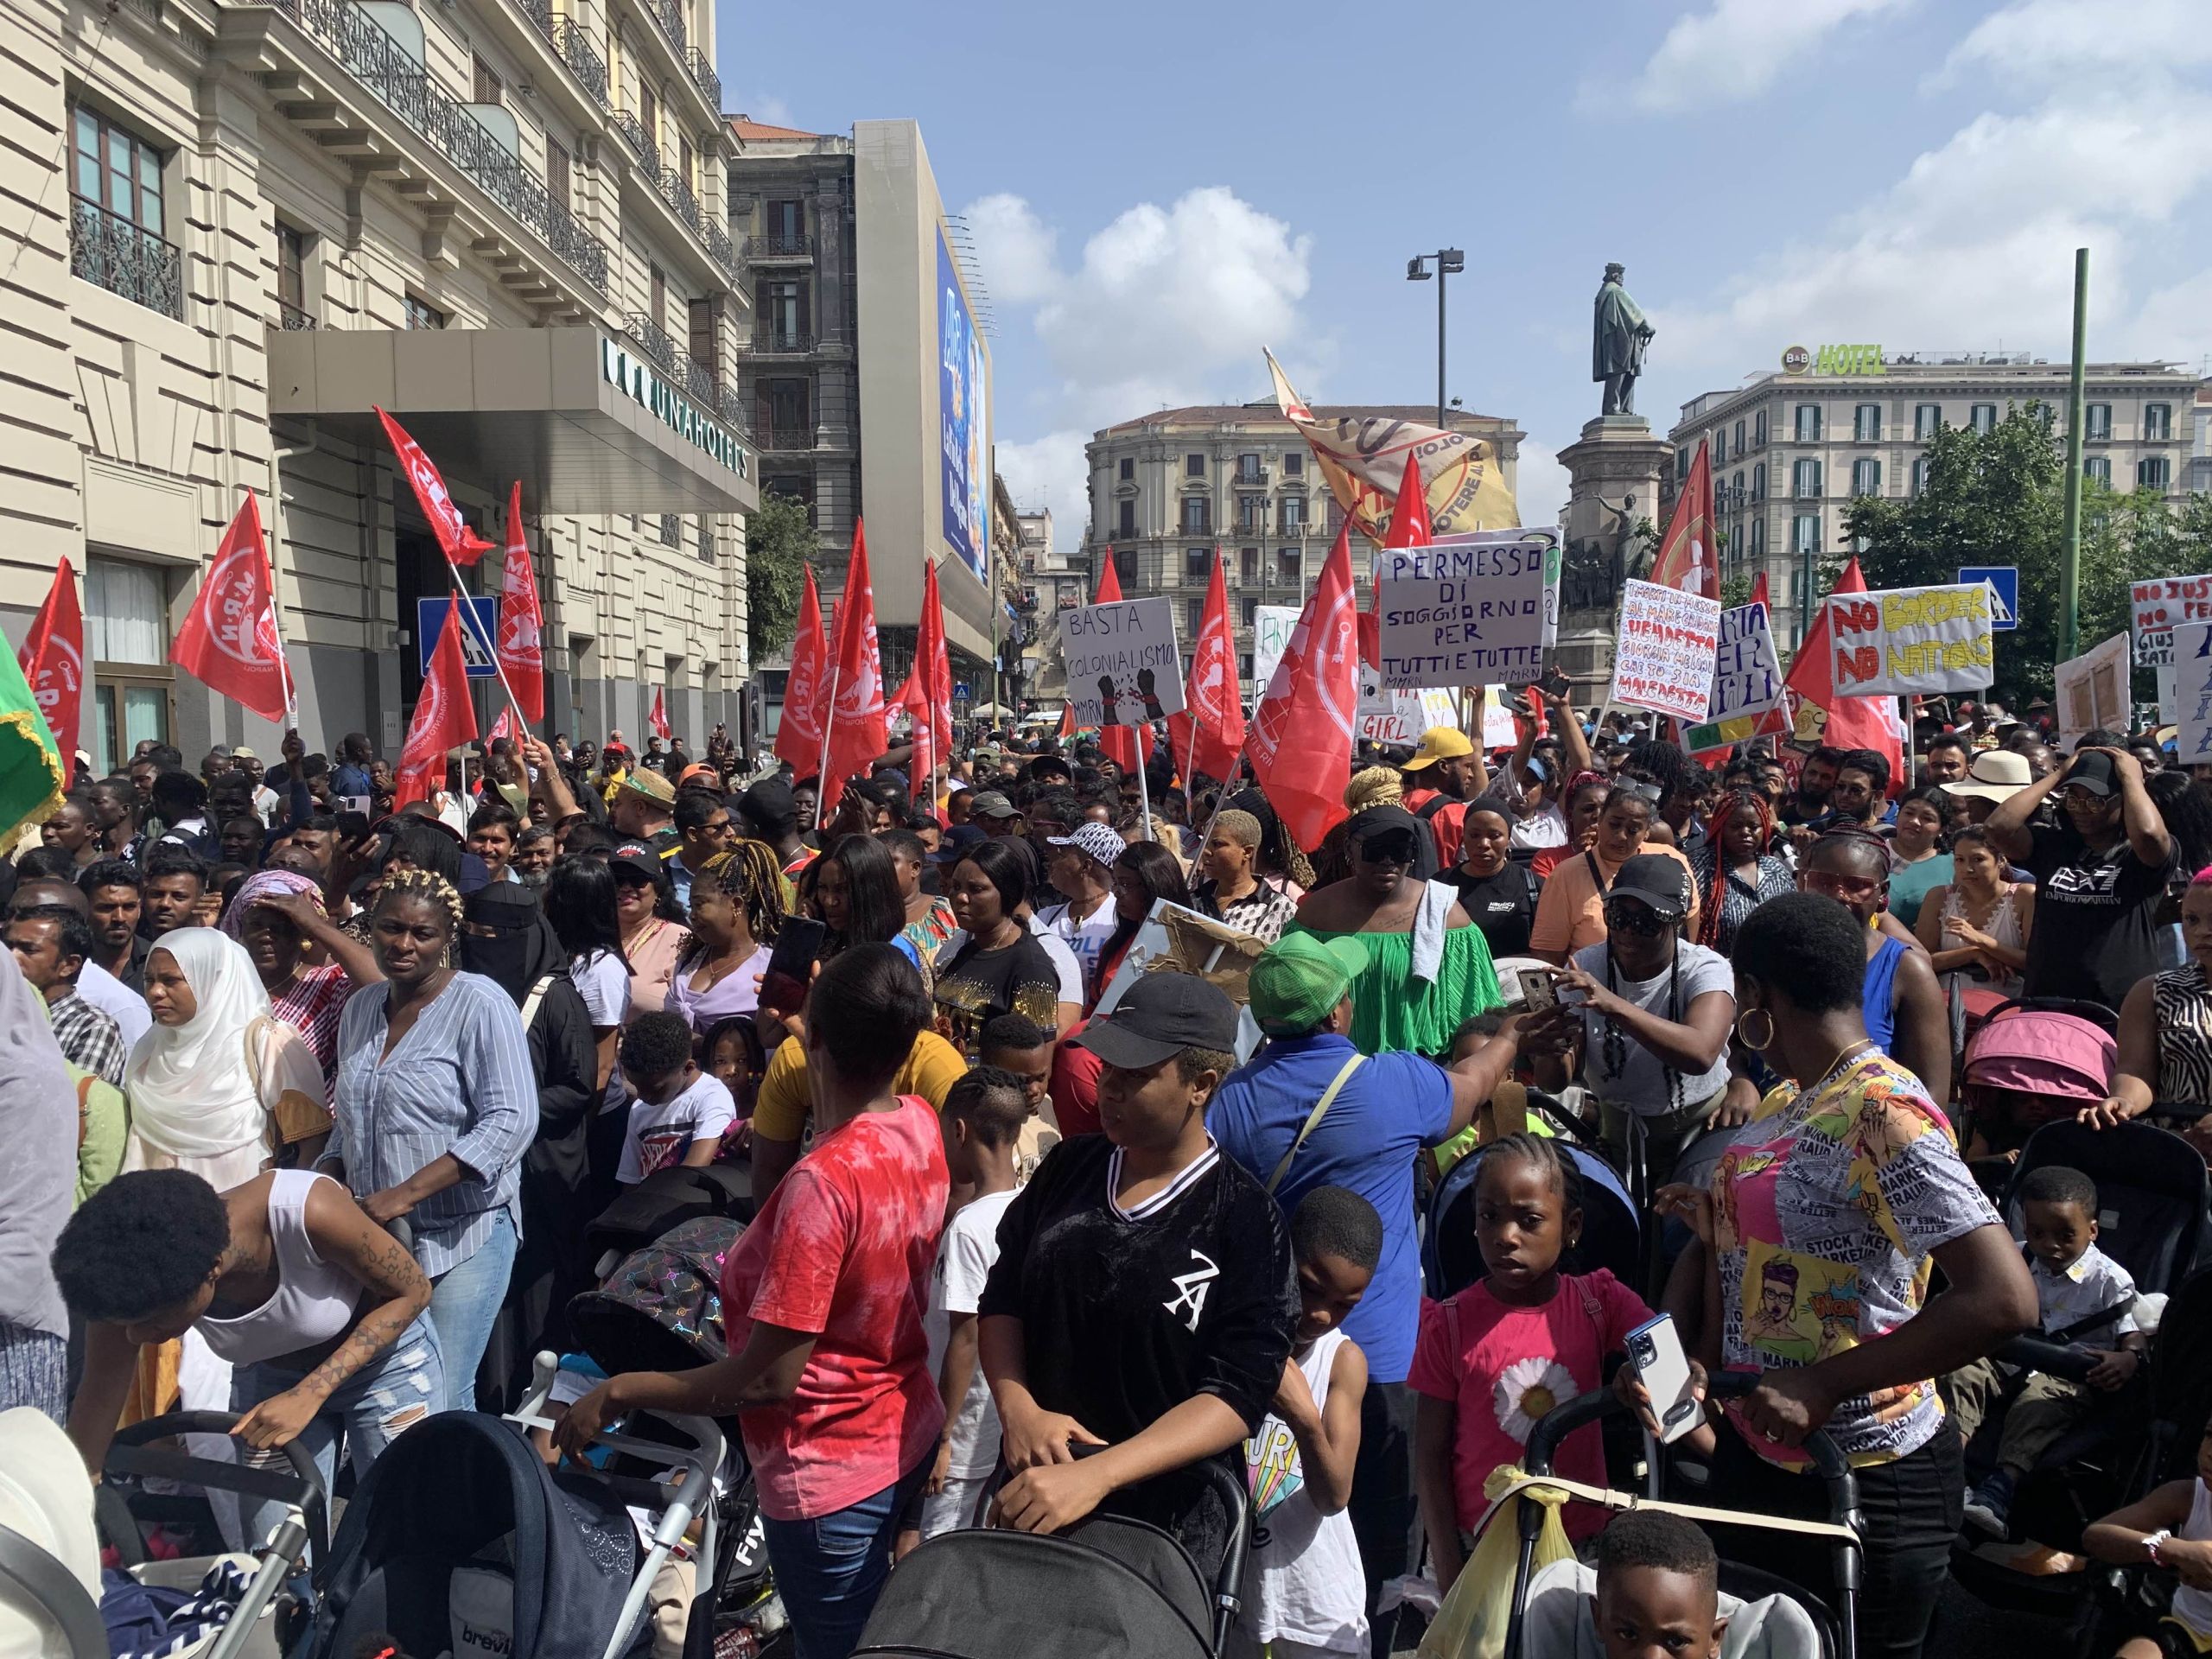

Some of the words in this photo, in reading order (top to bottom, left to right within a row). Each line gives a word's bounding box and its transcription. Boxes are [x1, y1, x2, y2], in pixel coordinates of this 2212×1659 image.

[1786, 353, 1808, 363] B&B
[1817, 344, 1886, 375] HOTEL
[1470, 464, 1484, 477] AL
[1393, 547, 1541, 582] PERMESSO
[2133, 585, 2162, 603] NO
[1070, 606, 1143, 636] BASTA
[1832, 601, 1878, 638] NO
[1883, 588, 1989, 632] BORDER
[2138, 609, 2168, 628] NO
[1434, 623, 1484, 646] PER
[1628, 620, 1716, 658] VENDETTA
[1068, 644, 1173, 678] COLONIALISMO
[1622, 640, 1670, 663] GIORGIA
[1673, 652, 1713, 674] MELONI
[1837, 645, 1879, 685] NO
[1385, 677, 1423, 690] MMRN
[1497, 669, 1540, 682] MMRN
[1671, 669, 1700, 689] SIA
[1617, 675, 1708, 711] MALEDETTA
[1073, 699, 1103, 724] MMRN
[1363, 715, 1408, 741] GIRL
[1806, 1234, 1853, 1255] STOCK
[462, 1624, 512, 1655] brevi
